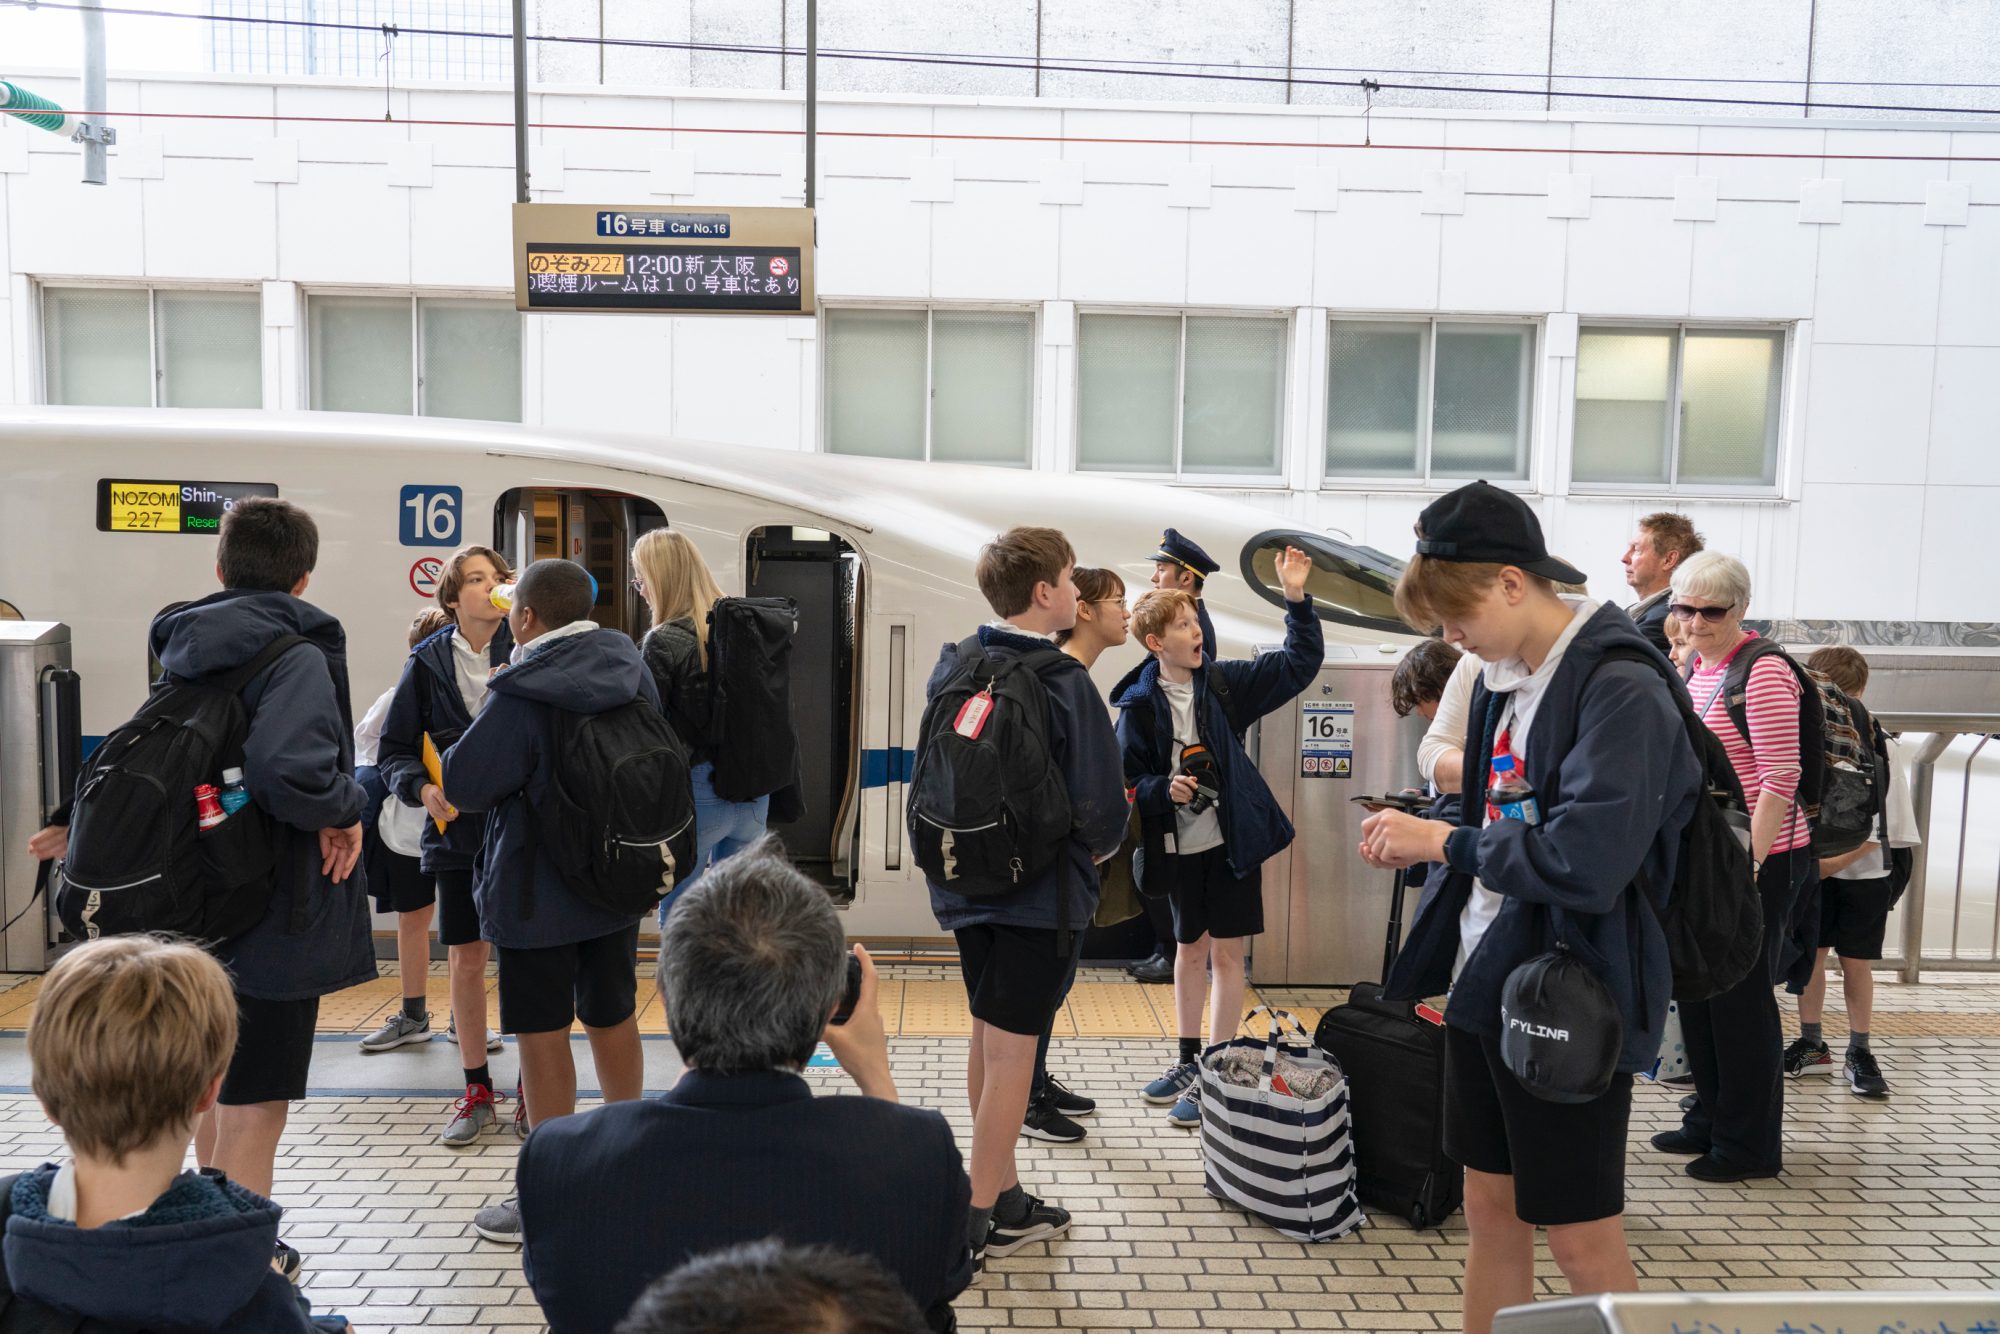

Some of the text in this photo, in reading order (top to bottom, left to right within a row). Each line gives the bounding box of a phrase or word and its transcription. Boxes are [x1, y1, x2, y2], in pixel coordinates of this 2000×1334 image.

[670, 222, 691, 234] Car
[693, 223, 727, 235] No.16
[626, 254, 682, 274] 12:00
[685, 254, 756, 276] 新大阪
[113, 486, 223, 507] NOZOMI Shin-
[126, 510, 163, 529] 227
[405, 492, 456, 540] 16
[1308, 716, 1334, 738] 16
[1510, 1018, 1569, 1042] FYLINA
